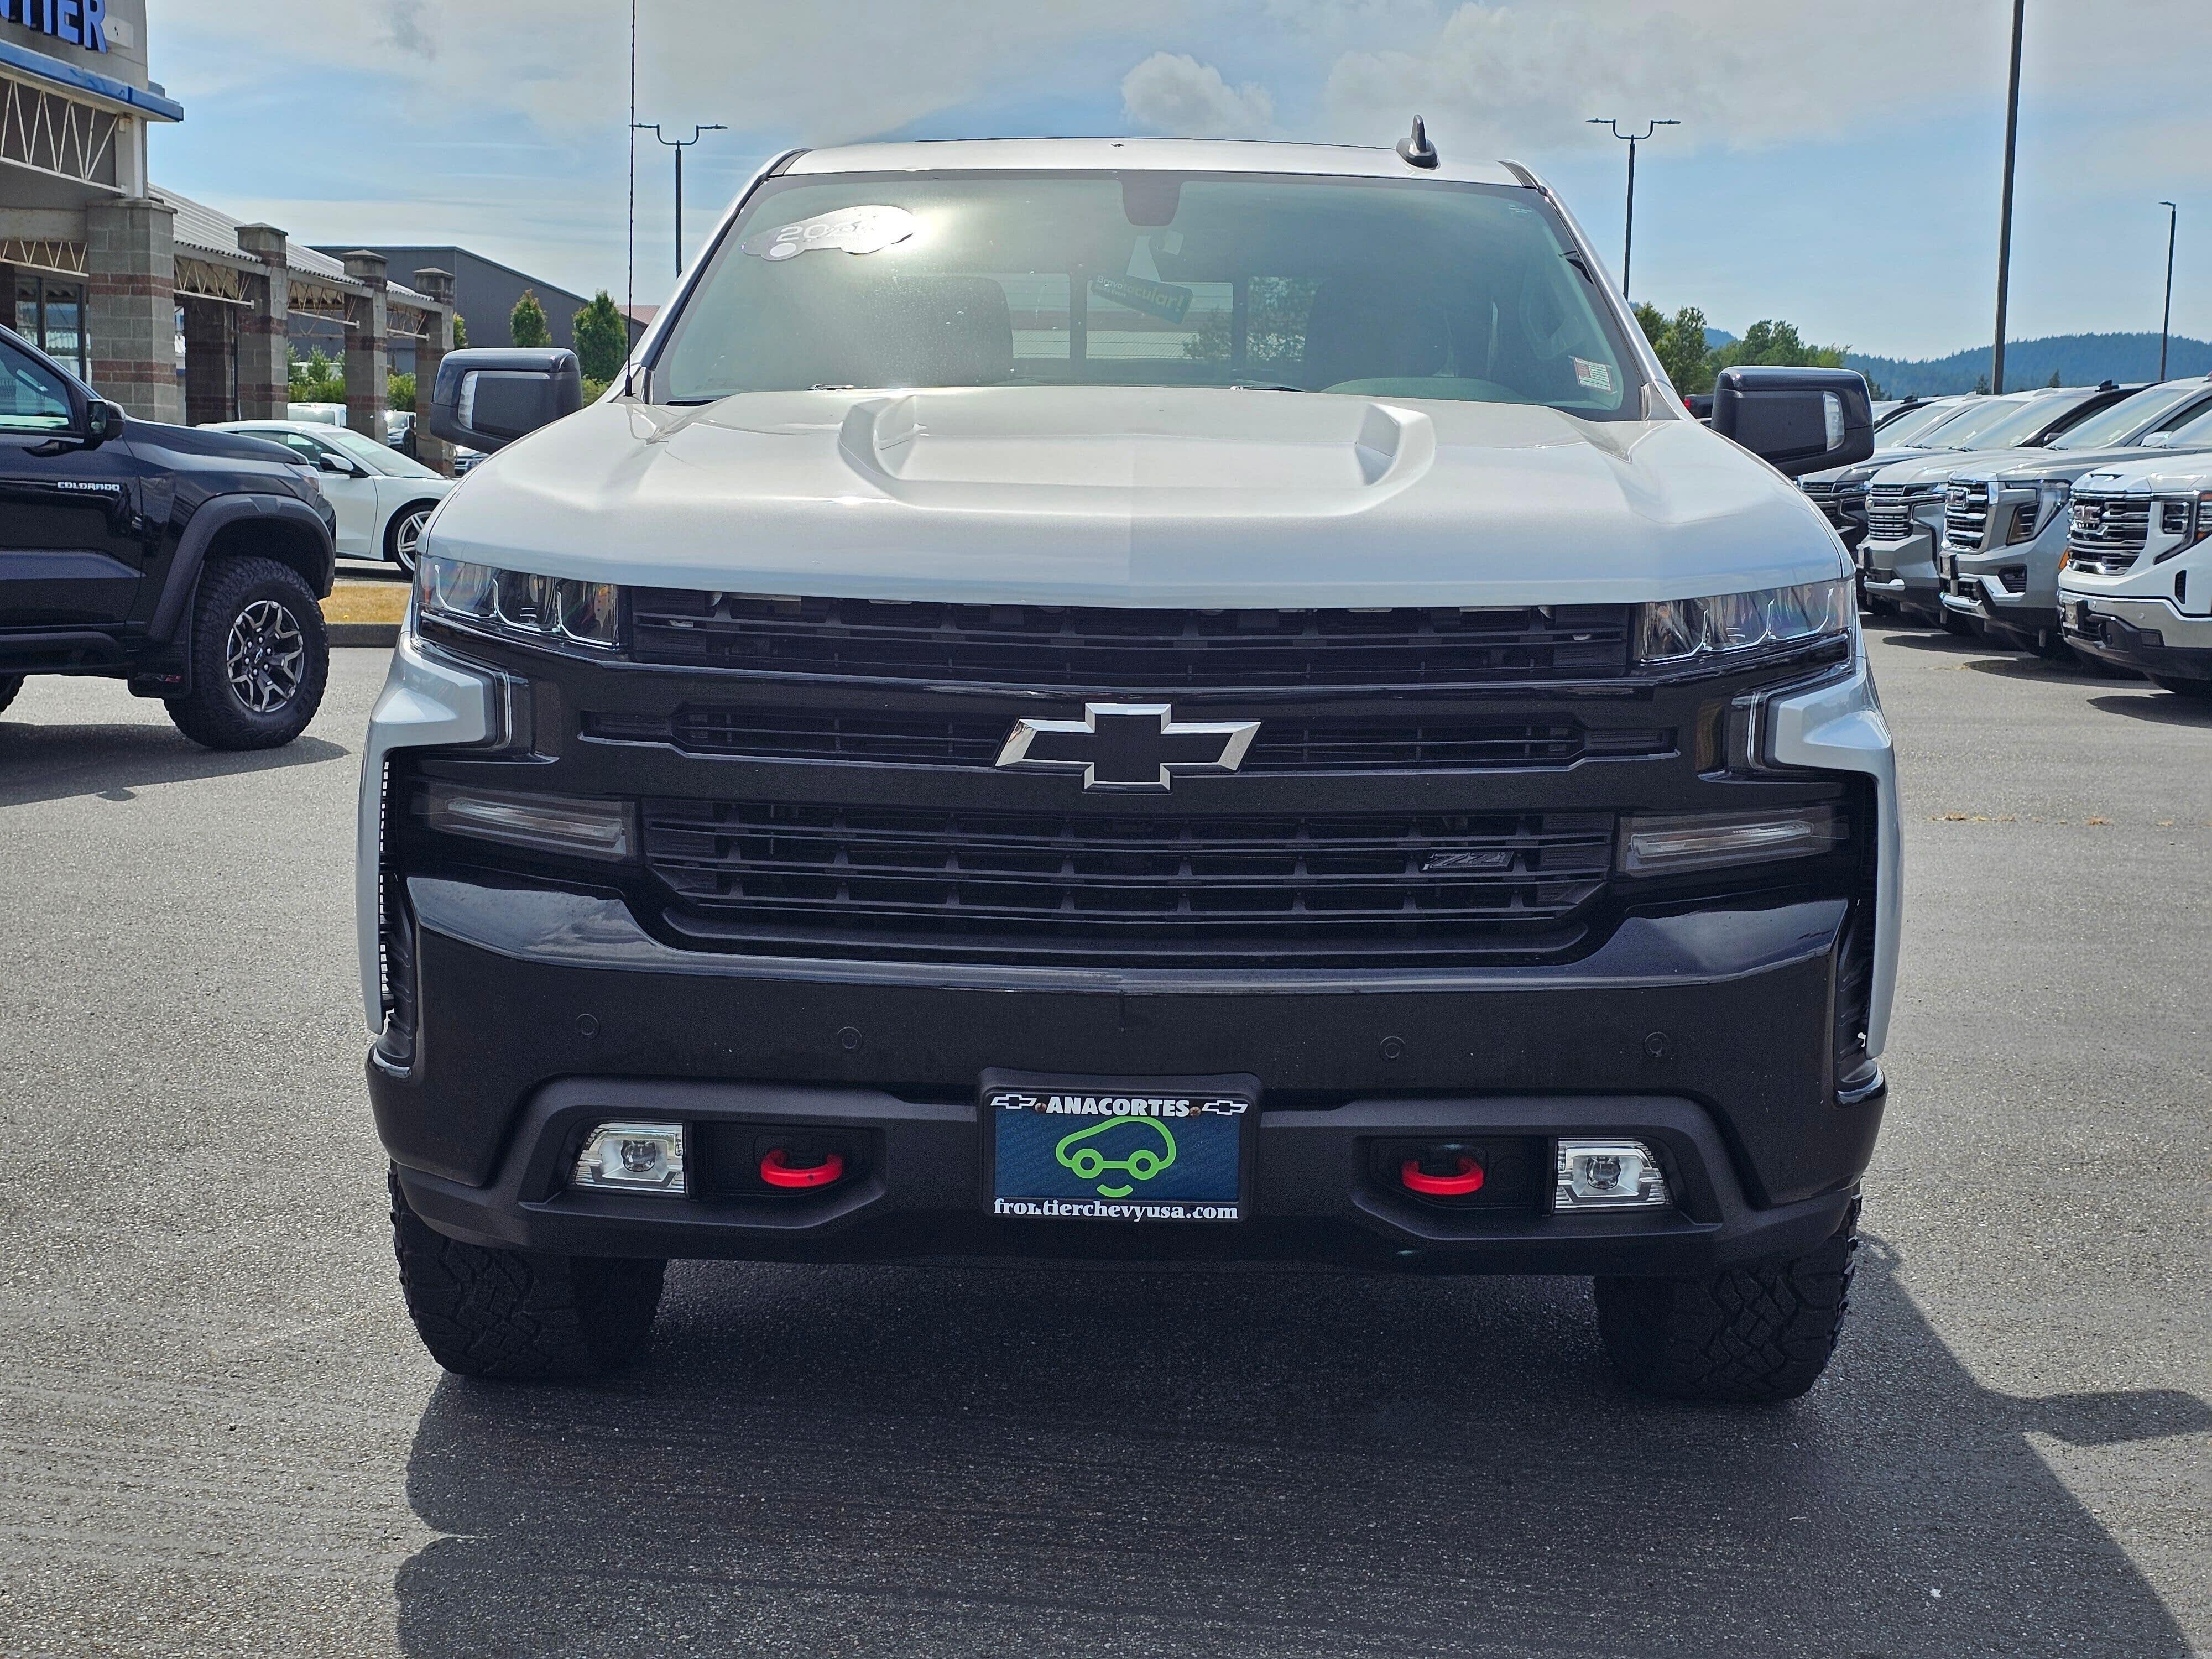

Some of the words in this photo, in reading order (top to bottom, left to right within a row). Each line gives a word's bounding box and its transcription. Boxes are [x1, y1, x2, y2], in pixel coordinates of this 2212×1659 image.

[57, 482, 120, 491] COLORADO
[1046, 1097, 1190, 1117] ANACORTES
[994, 1198, 1238, 1222] frontierchevyusa.com
